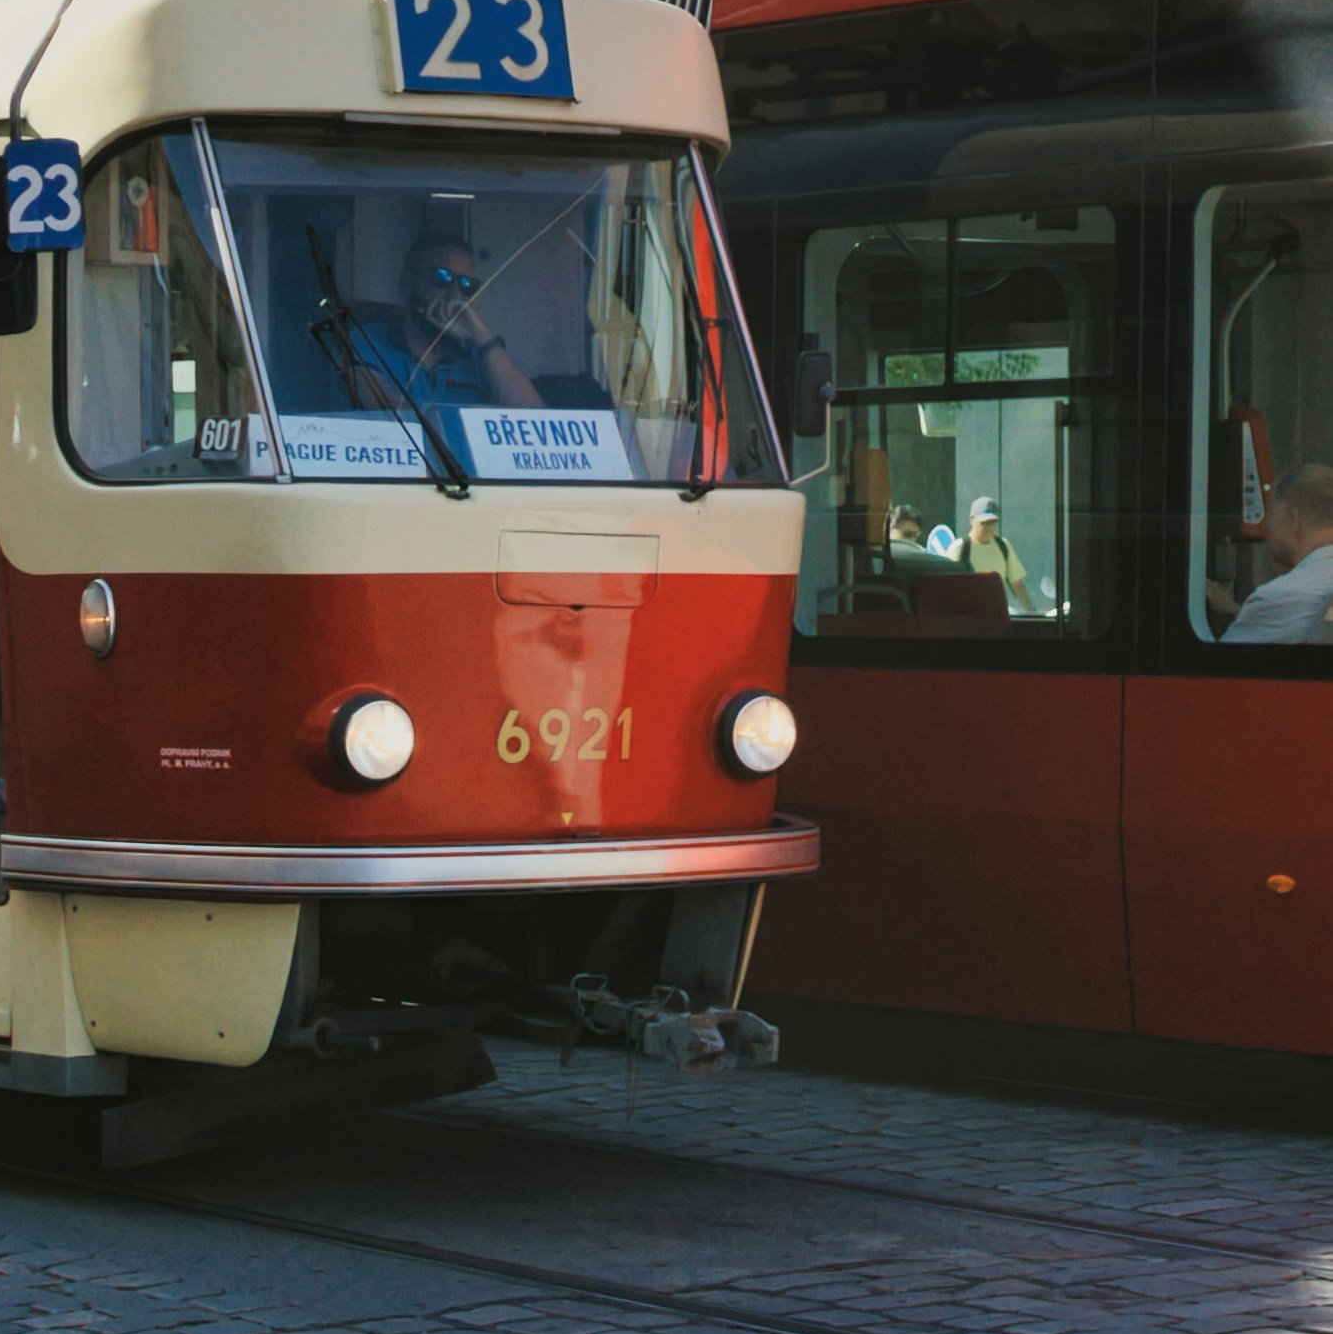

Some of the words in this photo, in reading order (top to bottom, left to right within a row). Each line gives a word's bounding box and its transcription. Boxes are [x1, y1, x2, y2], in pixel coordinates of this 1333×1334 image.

[6, 163, 83, 234] 23
[200, 418, 242, 452] 601
[484, 414, 600, 447] BŘEVNOV
[256, 440, 338, 463] PAGUE
[344, 444, 420, 467] CASTLE
[511, 448, 593, 471] KRÁLOVKA
[496, 706, 633, 764] 6921
